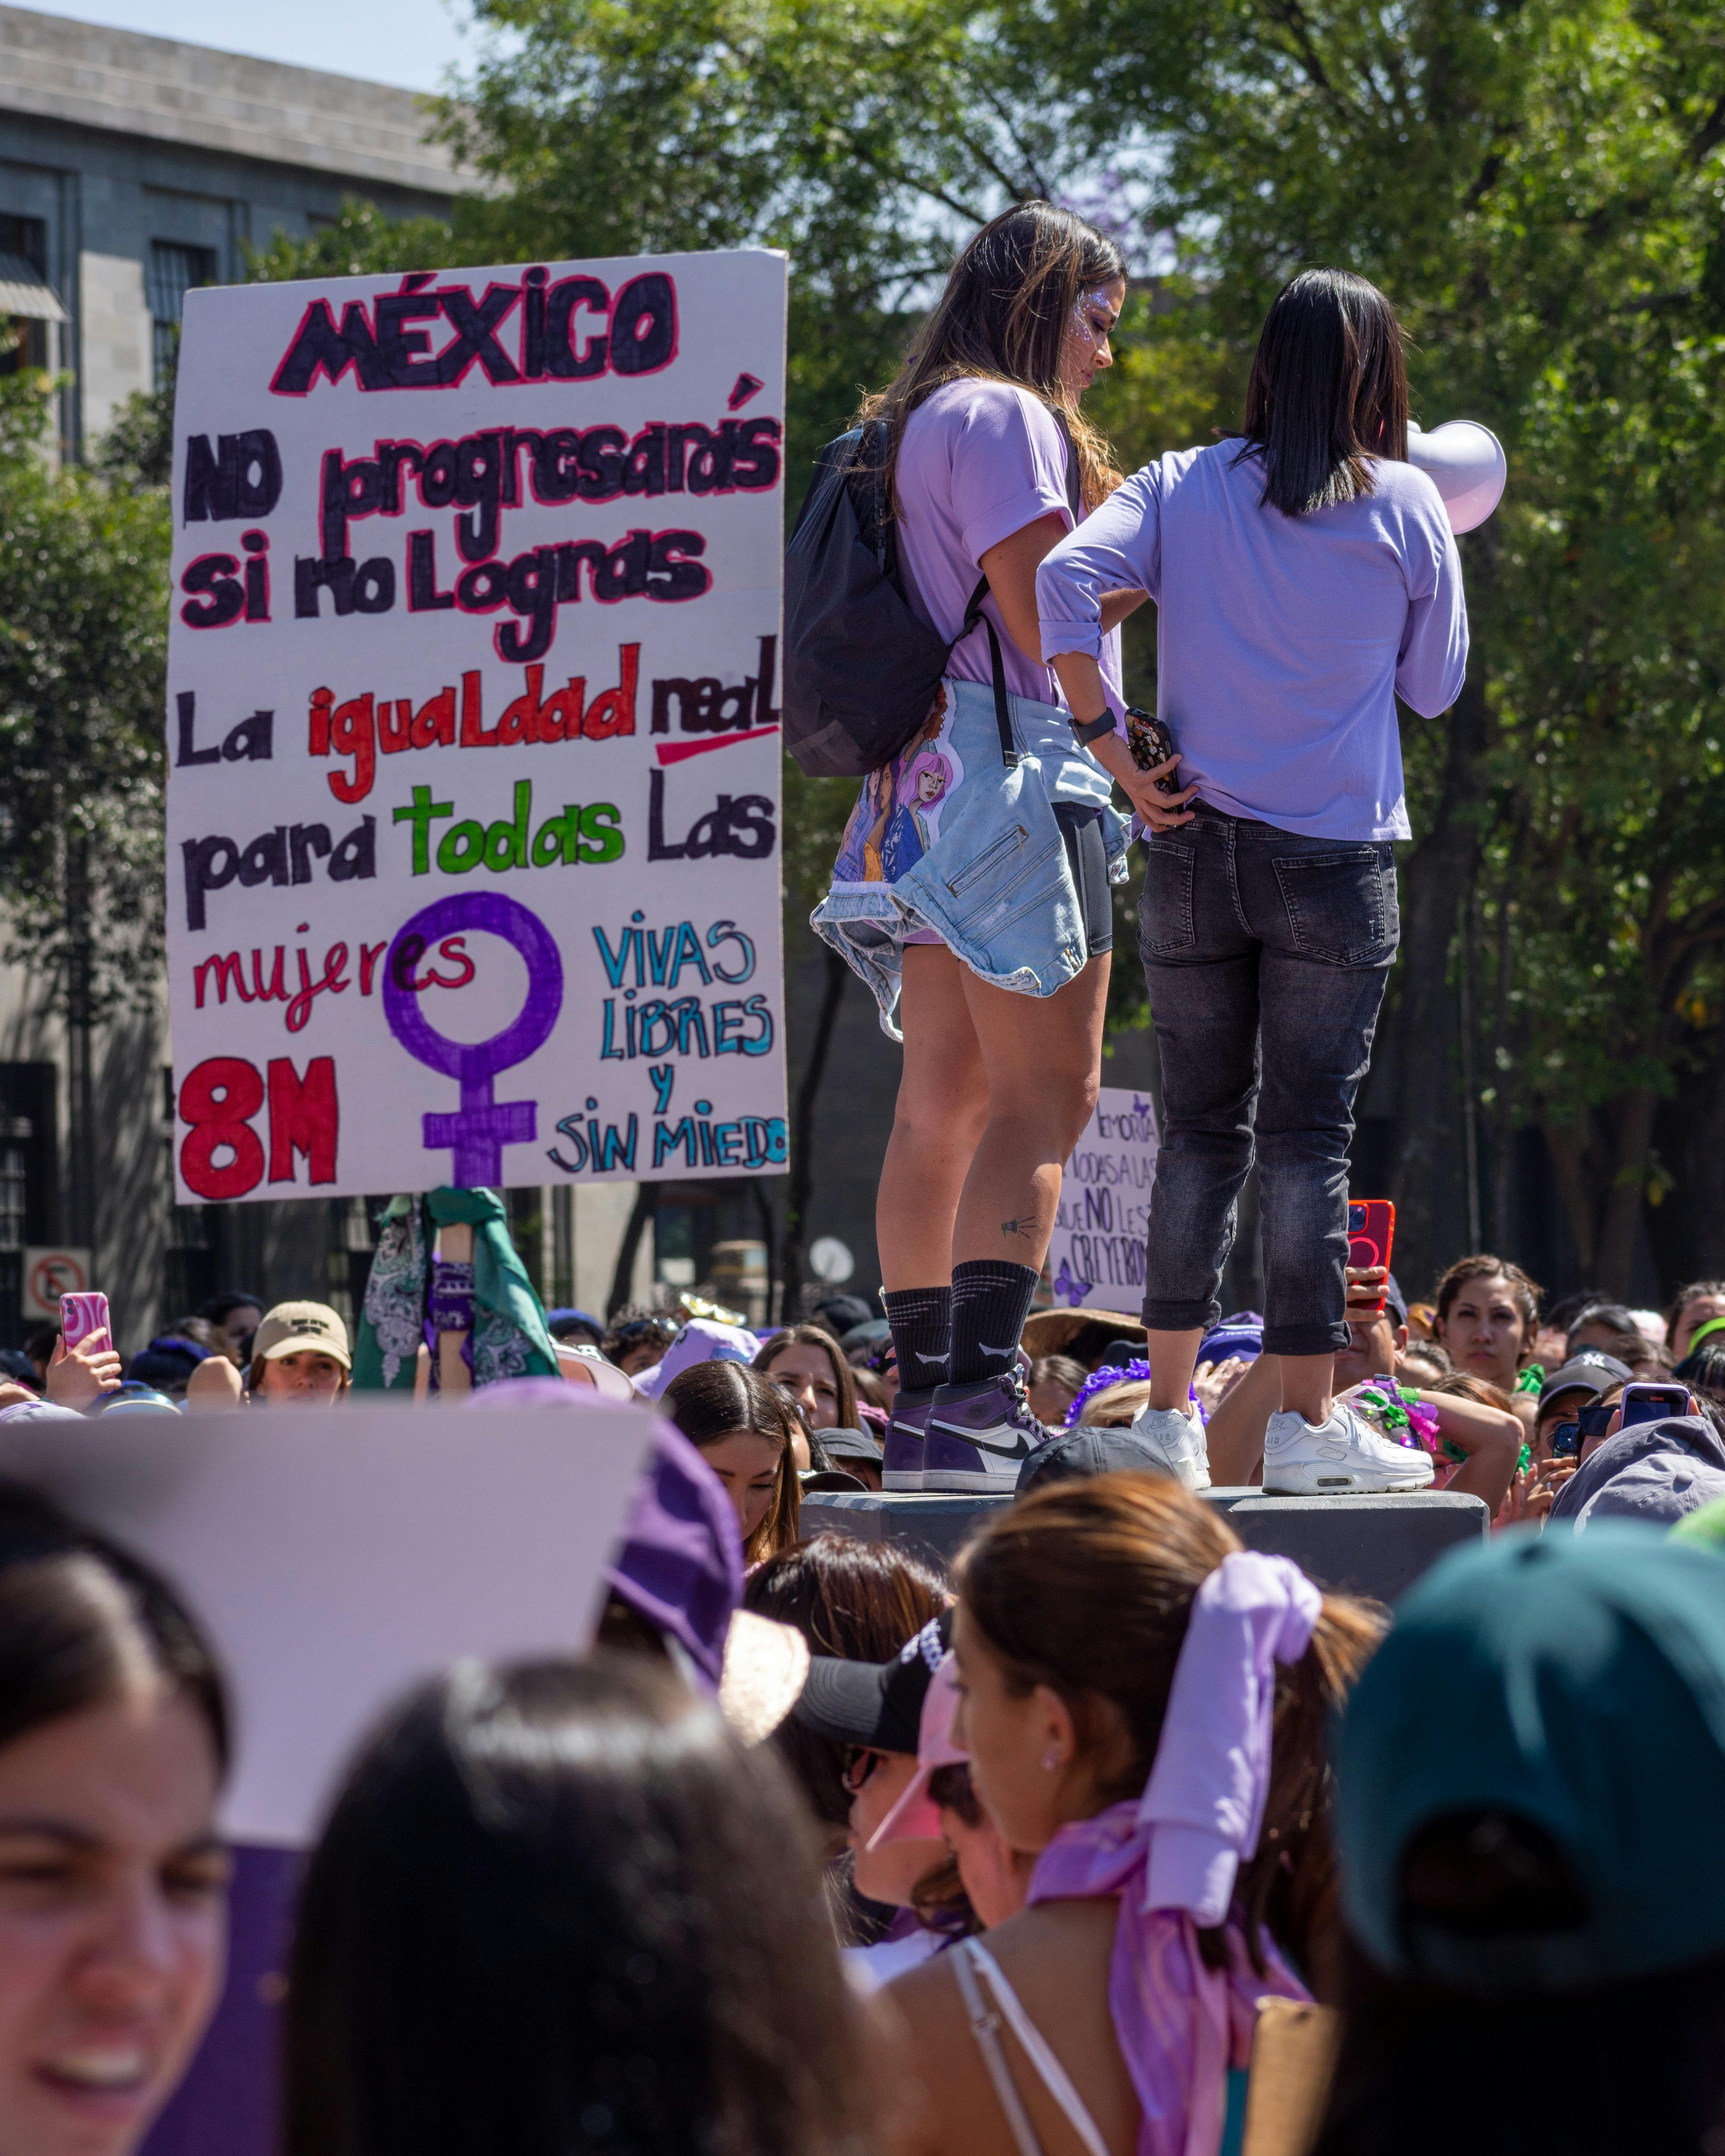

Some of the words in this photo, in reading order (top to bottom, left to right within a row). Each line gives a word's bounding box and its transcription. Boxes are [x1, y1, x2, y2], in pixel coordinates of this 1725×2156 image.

[183, 428, 283, 530] NO
[318, 373, 783, 563] progresarás
[294, 554, 395, 619] no
[174, 690, 274, 768] La
[181, 814, 376, 931] para
[193, 923, 475, 1033] mujeres
[179, 1056, 339, 1200] 8M
[1085, 1187, 1113, 1232] NO
